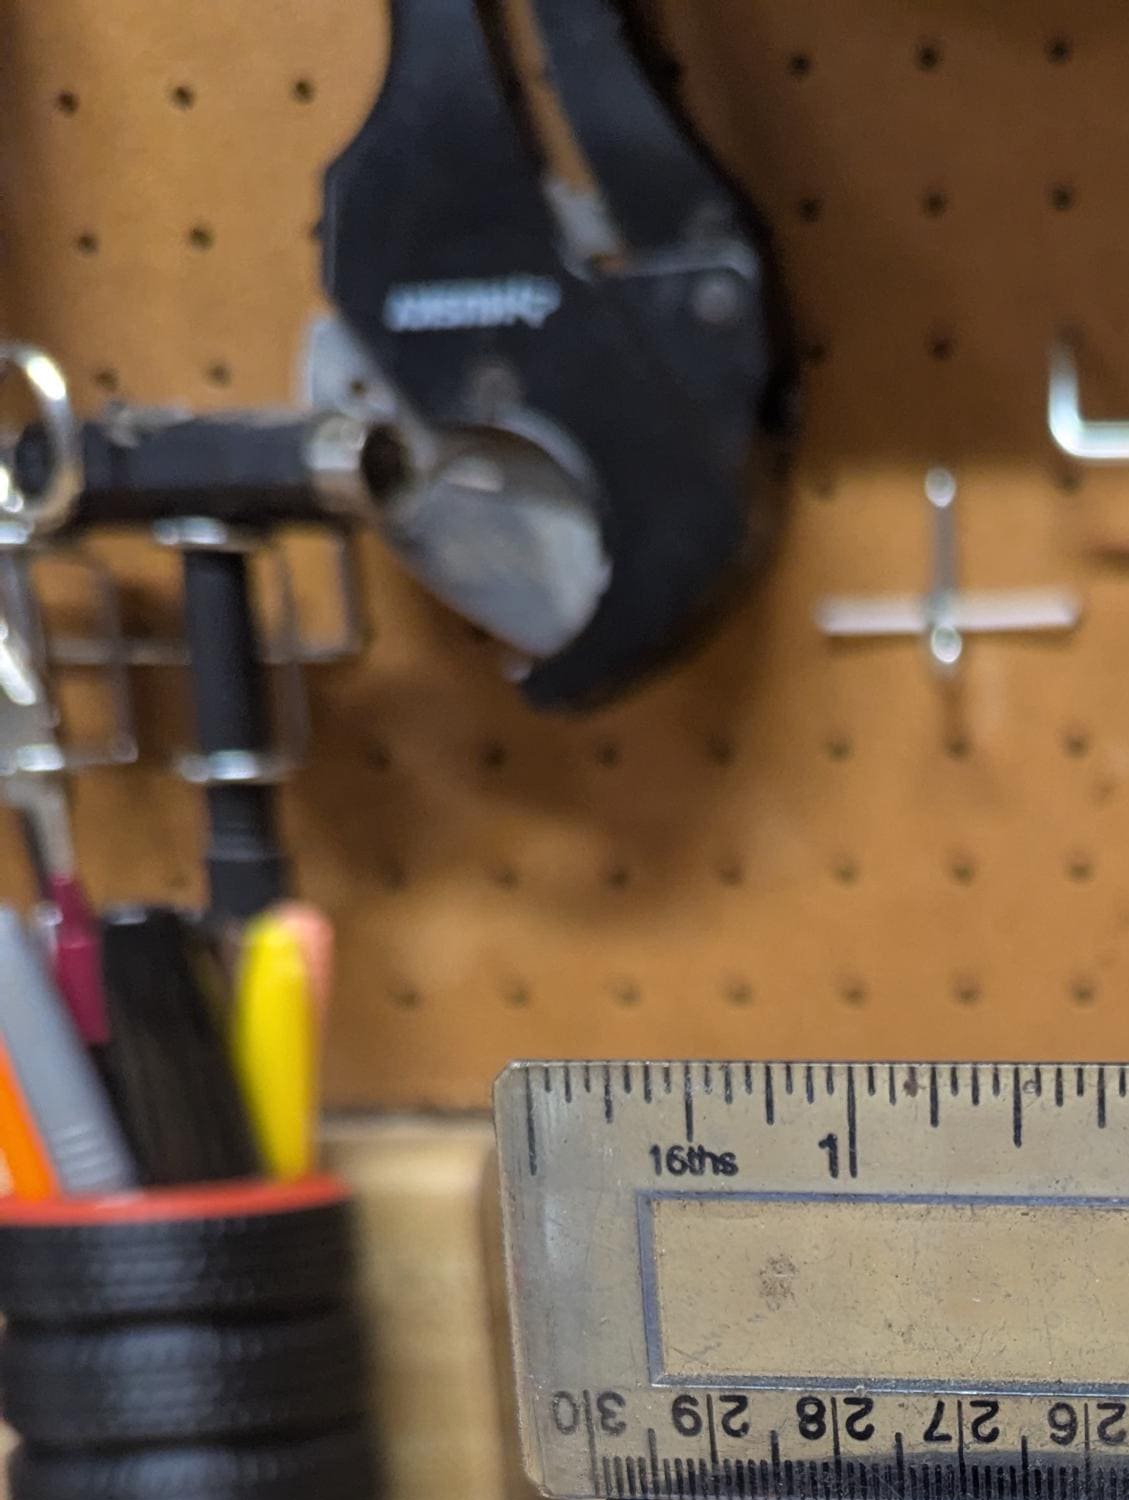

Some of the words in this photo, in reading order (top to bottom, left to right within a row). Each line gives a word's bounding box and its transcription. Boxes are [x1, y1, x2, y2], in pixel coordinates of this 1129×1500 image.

[648, 1143, 739, 1177] 16ths
[819, 1133, 838, 1178] 1
[554, 1391, 627, 1436] 30
[671, 1395, 750, 1438] 29
[796, 1396, 875, 1441] 28
[923, 1400, 1000, 1443] 27
[1047, 1402, 1127, 1445] 26
